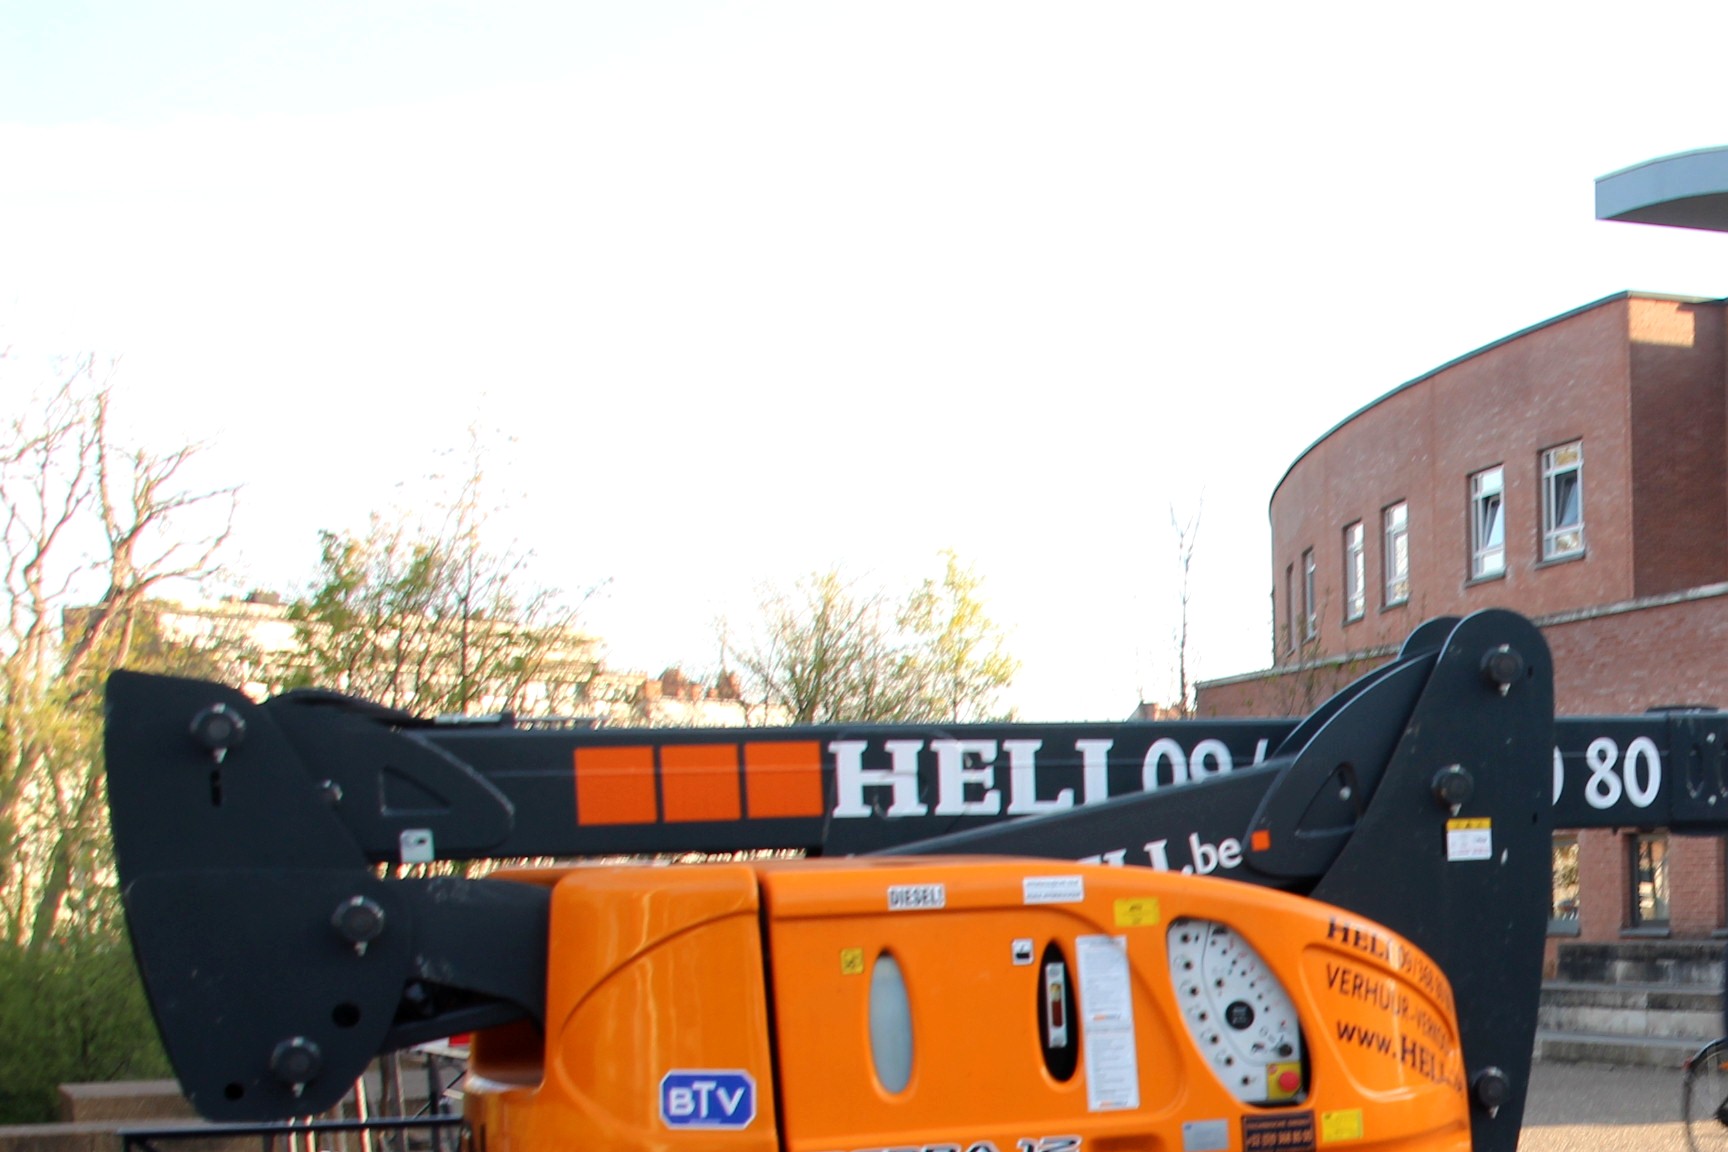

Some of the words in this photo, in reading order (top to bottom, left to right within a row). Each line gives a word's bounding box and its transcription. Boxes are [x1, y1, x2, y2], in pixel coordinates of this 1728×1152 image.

[828, 737, 1114, 818] HELI
[1584, 736, 1662, 809] 80
[669, 1080, 746, 1118] BTV
